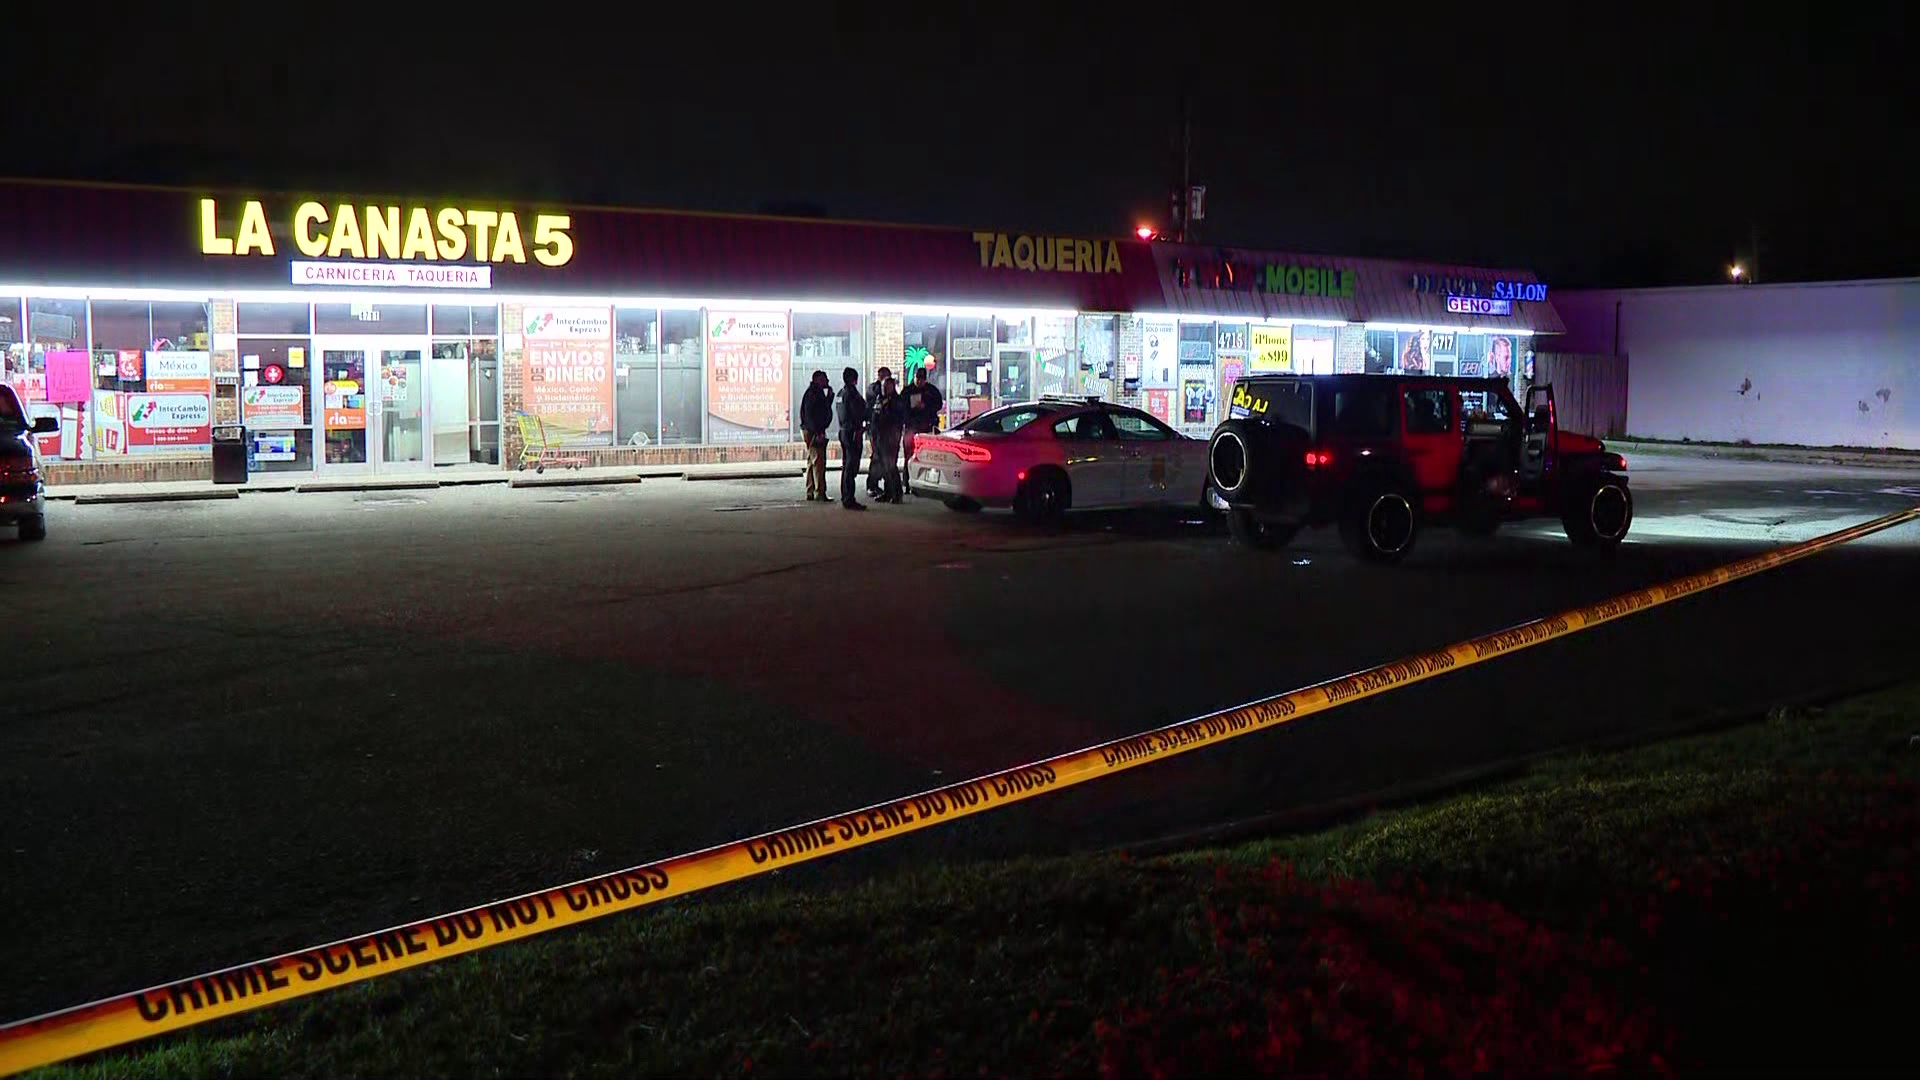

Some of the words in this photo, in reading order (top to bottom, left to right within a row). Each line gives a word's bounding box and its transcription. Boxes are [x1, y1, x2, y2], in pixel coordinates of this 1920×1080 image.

[201, 199, 275, 256] LA
[294, 201, 527, 263] CANASTA
[533, 214, 574, 266] 5
[973, 231, 1122, 273] TAQUERIA
[305, 266, 396, 282] CARNICERIA
[407, 268, 479, 284] TAQUERIA
[1266, 264, 1356, 297] MOBILE
[1494, 280, 1548, 301] SALON
[1448, 297, 1492, 313] GENO
[570, 326, 601, 334] Express
[1218, 332, 1243, 349] 4715
[1255, 333, 1288, 345] iPhone
[1432, 334, 1454, 351] 4717
[159, 360, 197, 370] México
[529, 350, 605, 366] ENVIOS
[714, 352, 783, 367] ENVIOS
[545, 366, 606, 383] DINERO
[728, 367, 783, 383] DINERO
[329, 412, 348, 425] ria
[746, 822, 835, 864] CRIME
[837, 803, 914, 841] SCENE
[914, 794, 947, 819] DO
[949, 784, 991, 810] NOT
[996, 764, 1057, 798] CROSS
[136, 960, 289, 1022] CRIME
[297, 927, 428, 982] SCENE
[430, 910, 483, 947] DO
[486, 895, 556, 933] NOT
[561, 865, 669, 912] CROSS
